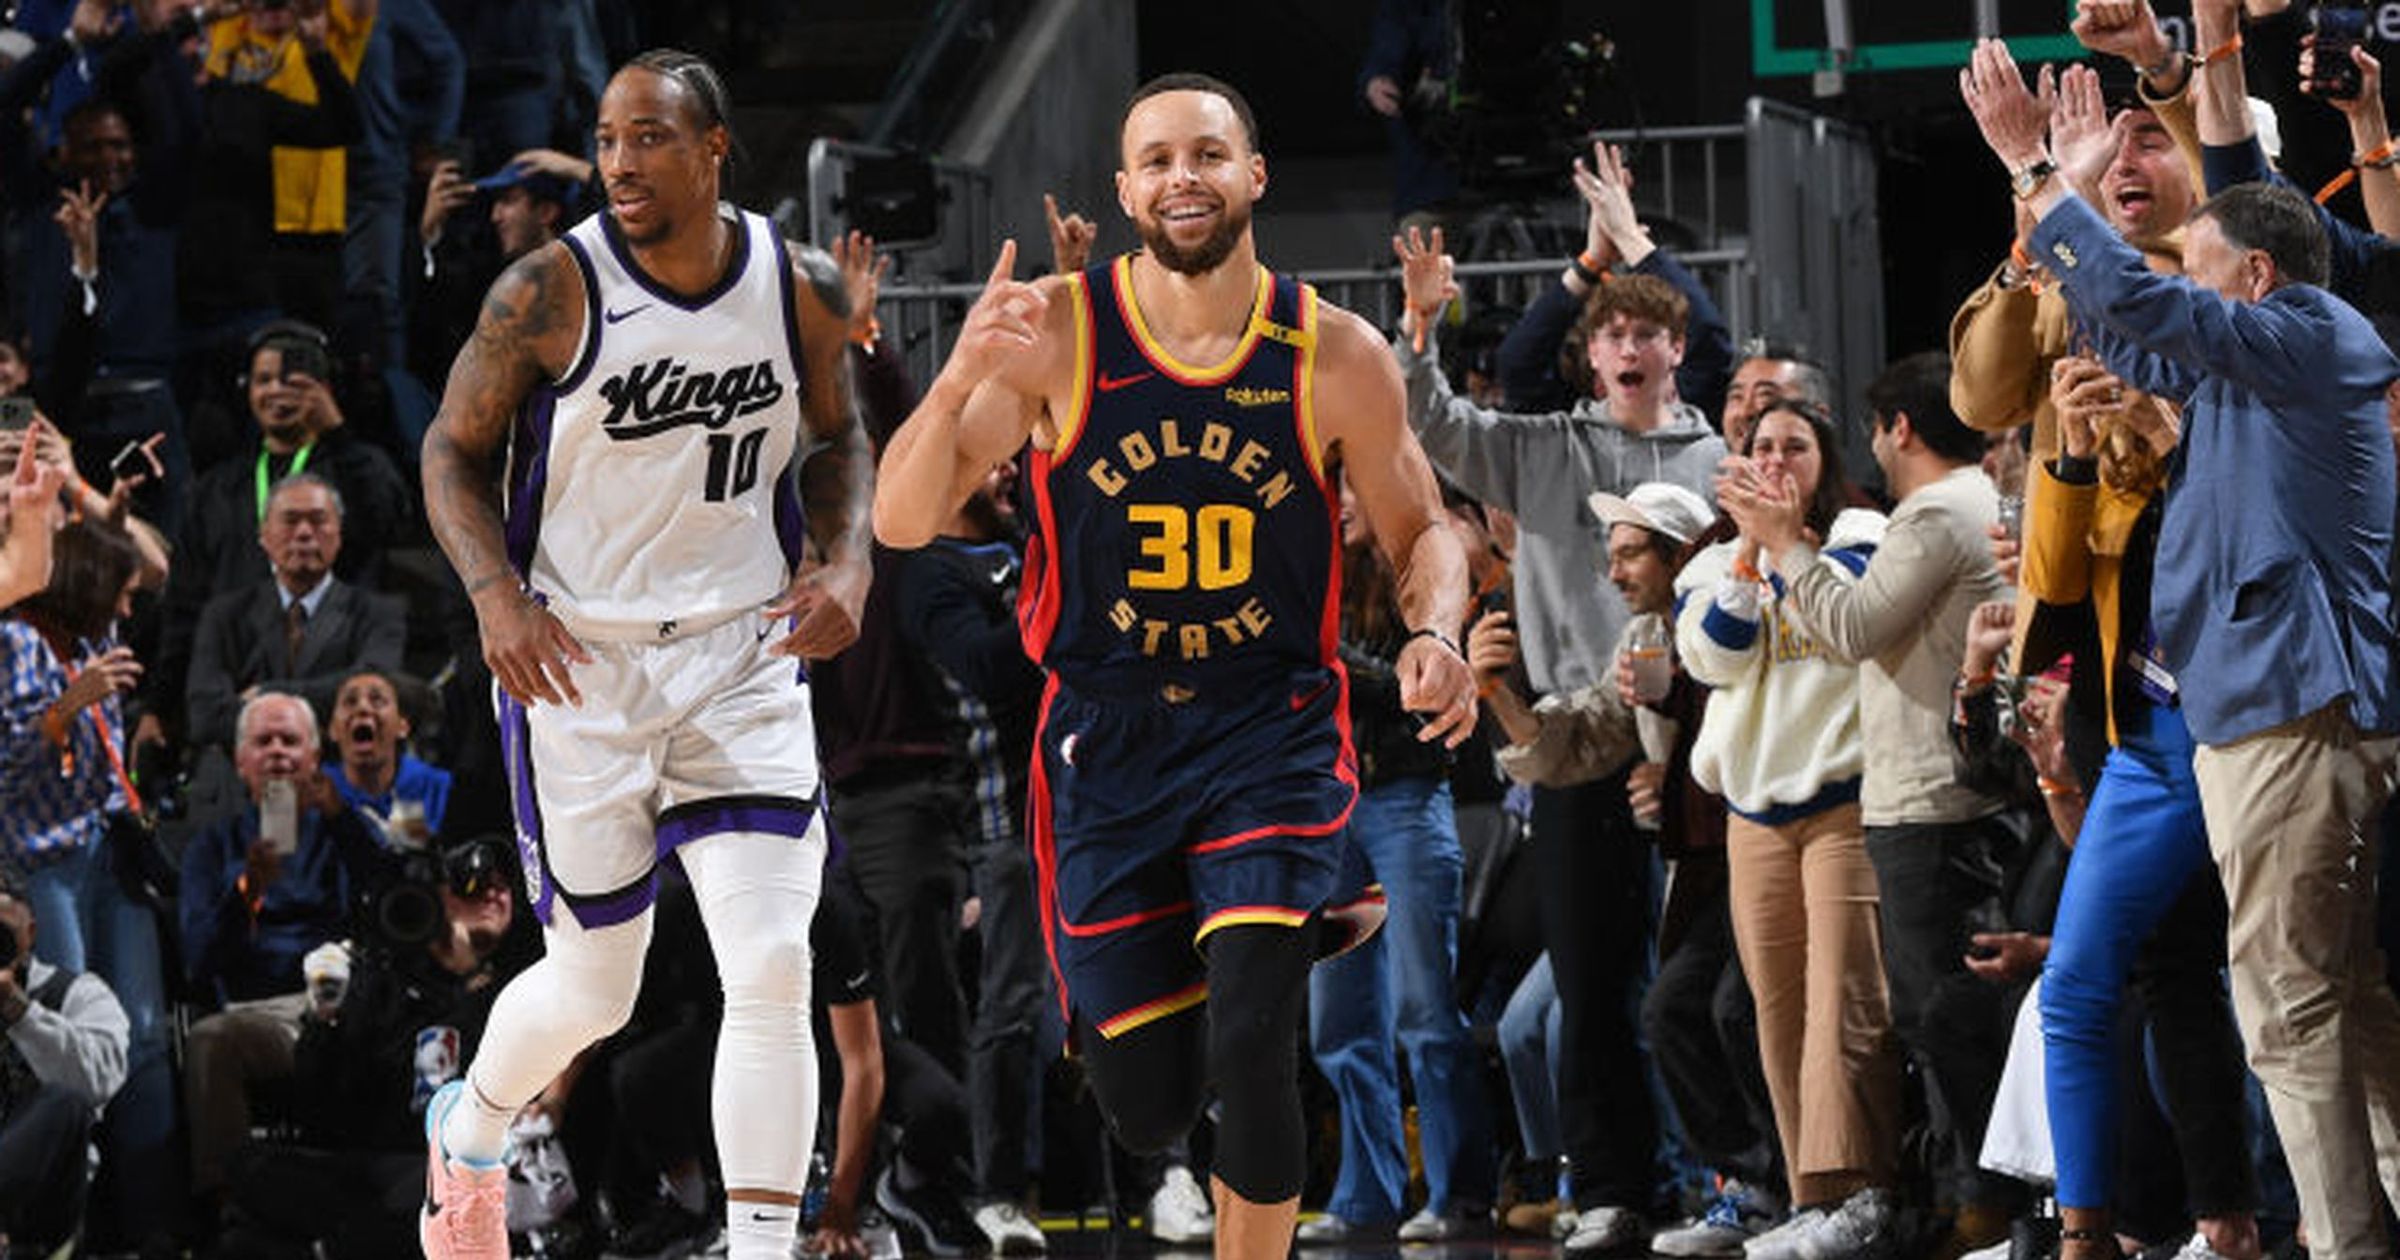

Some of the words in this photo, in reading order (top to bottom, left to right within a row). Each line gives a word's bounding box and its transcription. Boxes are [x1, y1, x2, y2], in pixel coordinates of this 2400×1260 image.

[599, 357, 784, 441] Kings
[704, 427, 770, 502] 10
[1087, 419, 1296, 509] GOLDEN
[1127, 504, 1256, 591] 30
[1108, 598, 1273, 661] STATE
